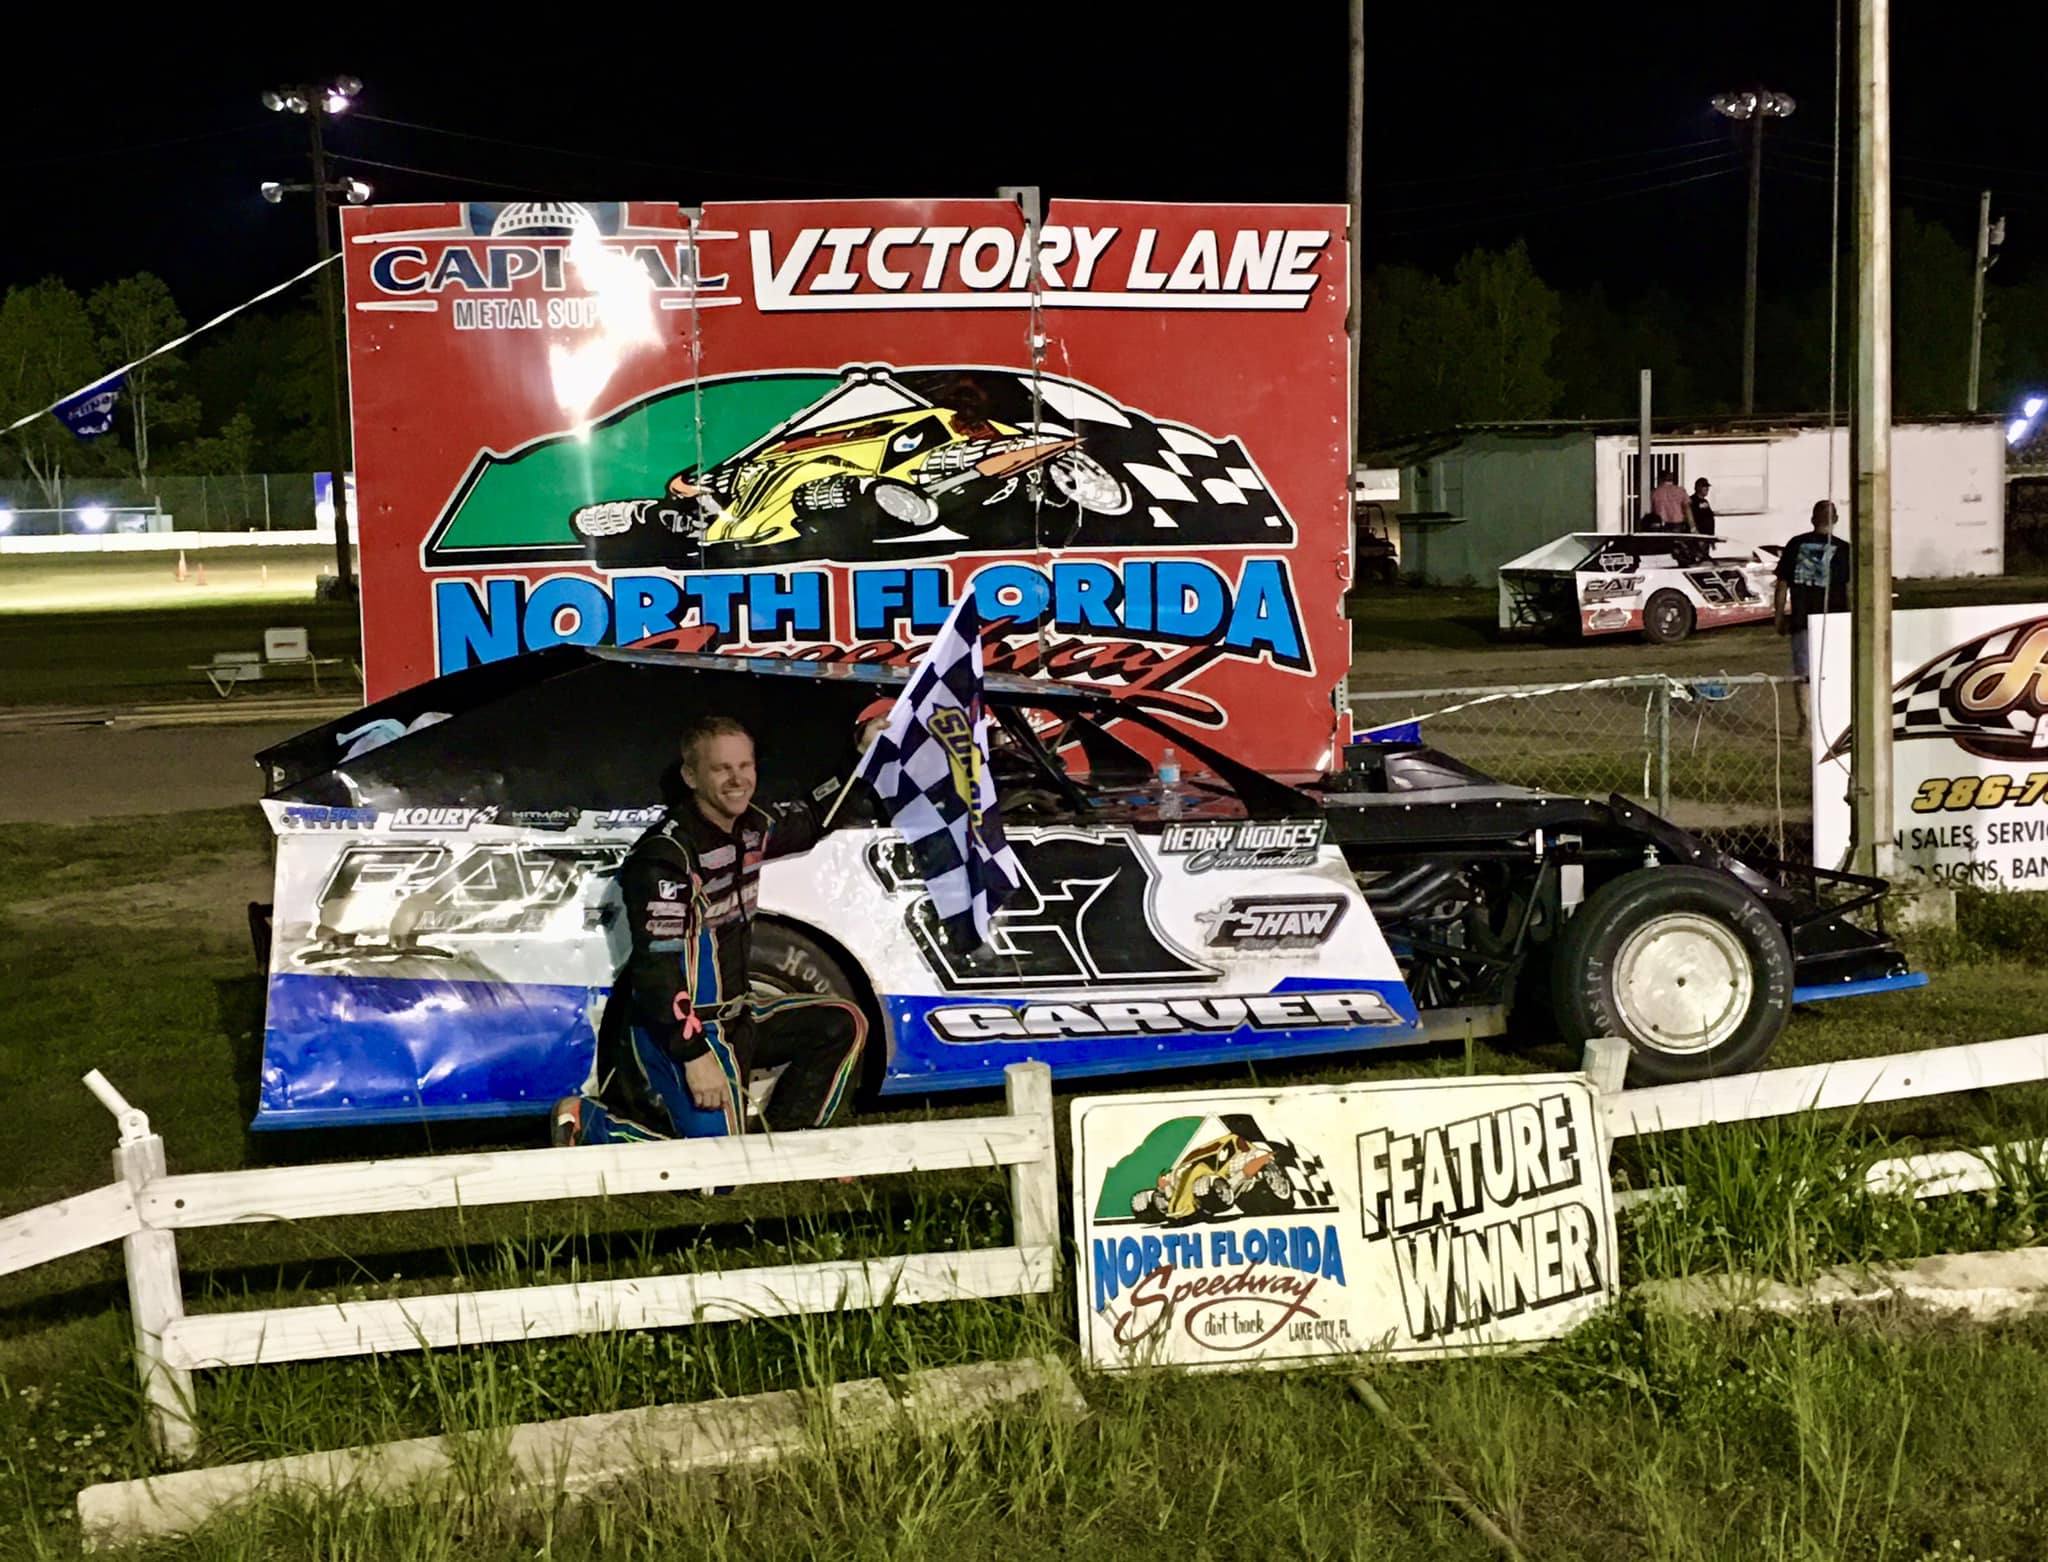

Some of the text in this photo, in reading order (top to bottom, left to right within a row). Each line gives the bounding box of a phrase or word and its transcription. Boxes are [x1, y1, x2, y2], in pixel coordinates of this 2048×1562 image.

[370, 245, 729, 295] CAPIAL
[749, 226, 1330, 311] VICTORY LANE
[453, 297, 602, 330] METAL SUP
[436, 560, 1309, 677] NORTH FLORIDA
[1911, 772, 2048, 814] 386-7
[1163, 825, 1321, 851] HENRY HODGES
[1987, 819, 2048, 845] SERVI
[1187, 847, 1314, 872] Construction
[1233, 904, 1334, 937] SHAW
[928, 992, 1400, 1042] GARVER
[1357, 1093, 1583, 1242] FEATURE
[1093, 1225, 1347, 1312] NORTH FLORIDA
[1392, 1201, 1603, 1342] WINNER
[1113, 1260, 1321, 1351] Speedway
[1204, 1309, 1265, 1336] dirt track
[1289, 1321, 1313, 1342] LAKE
